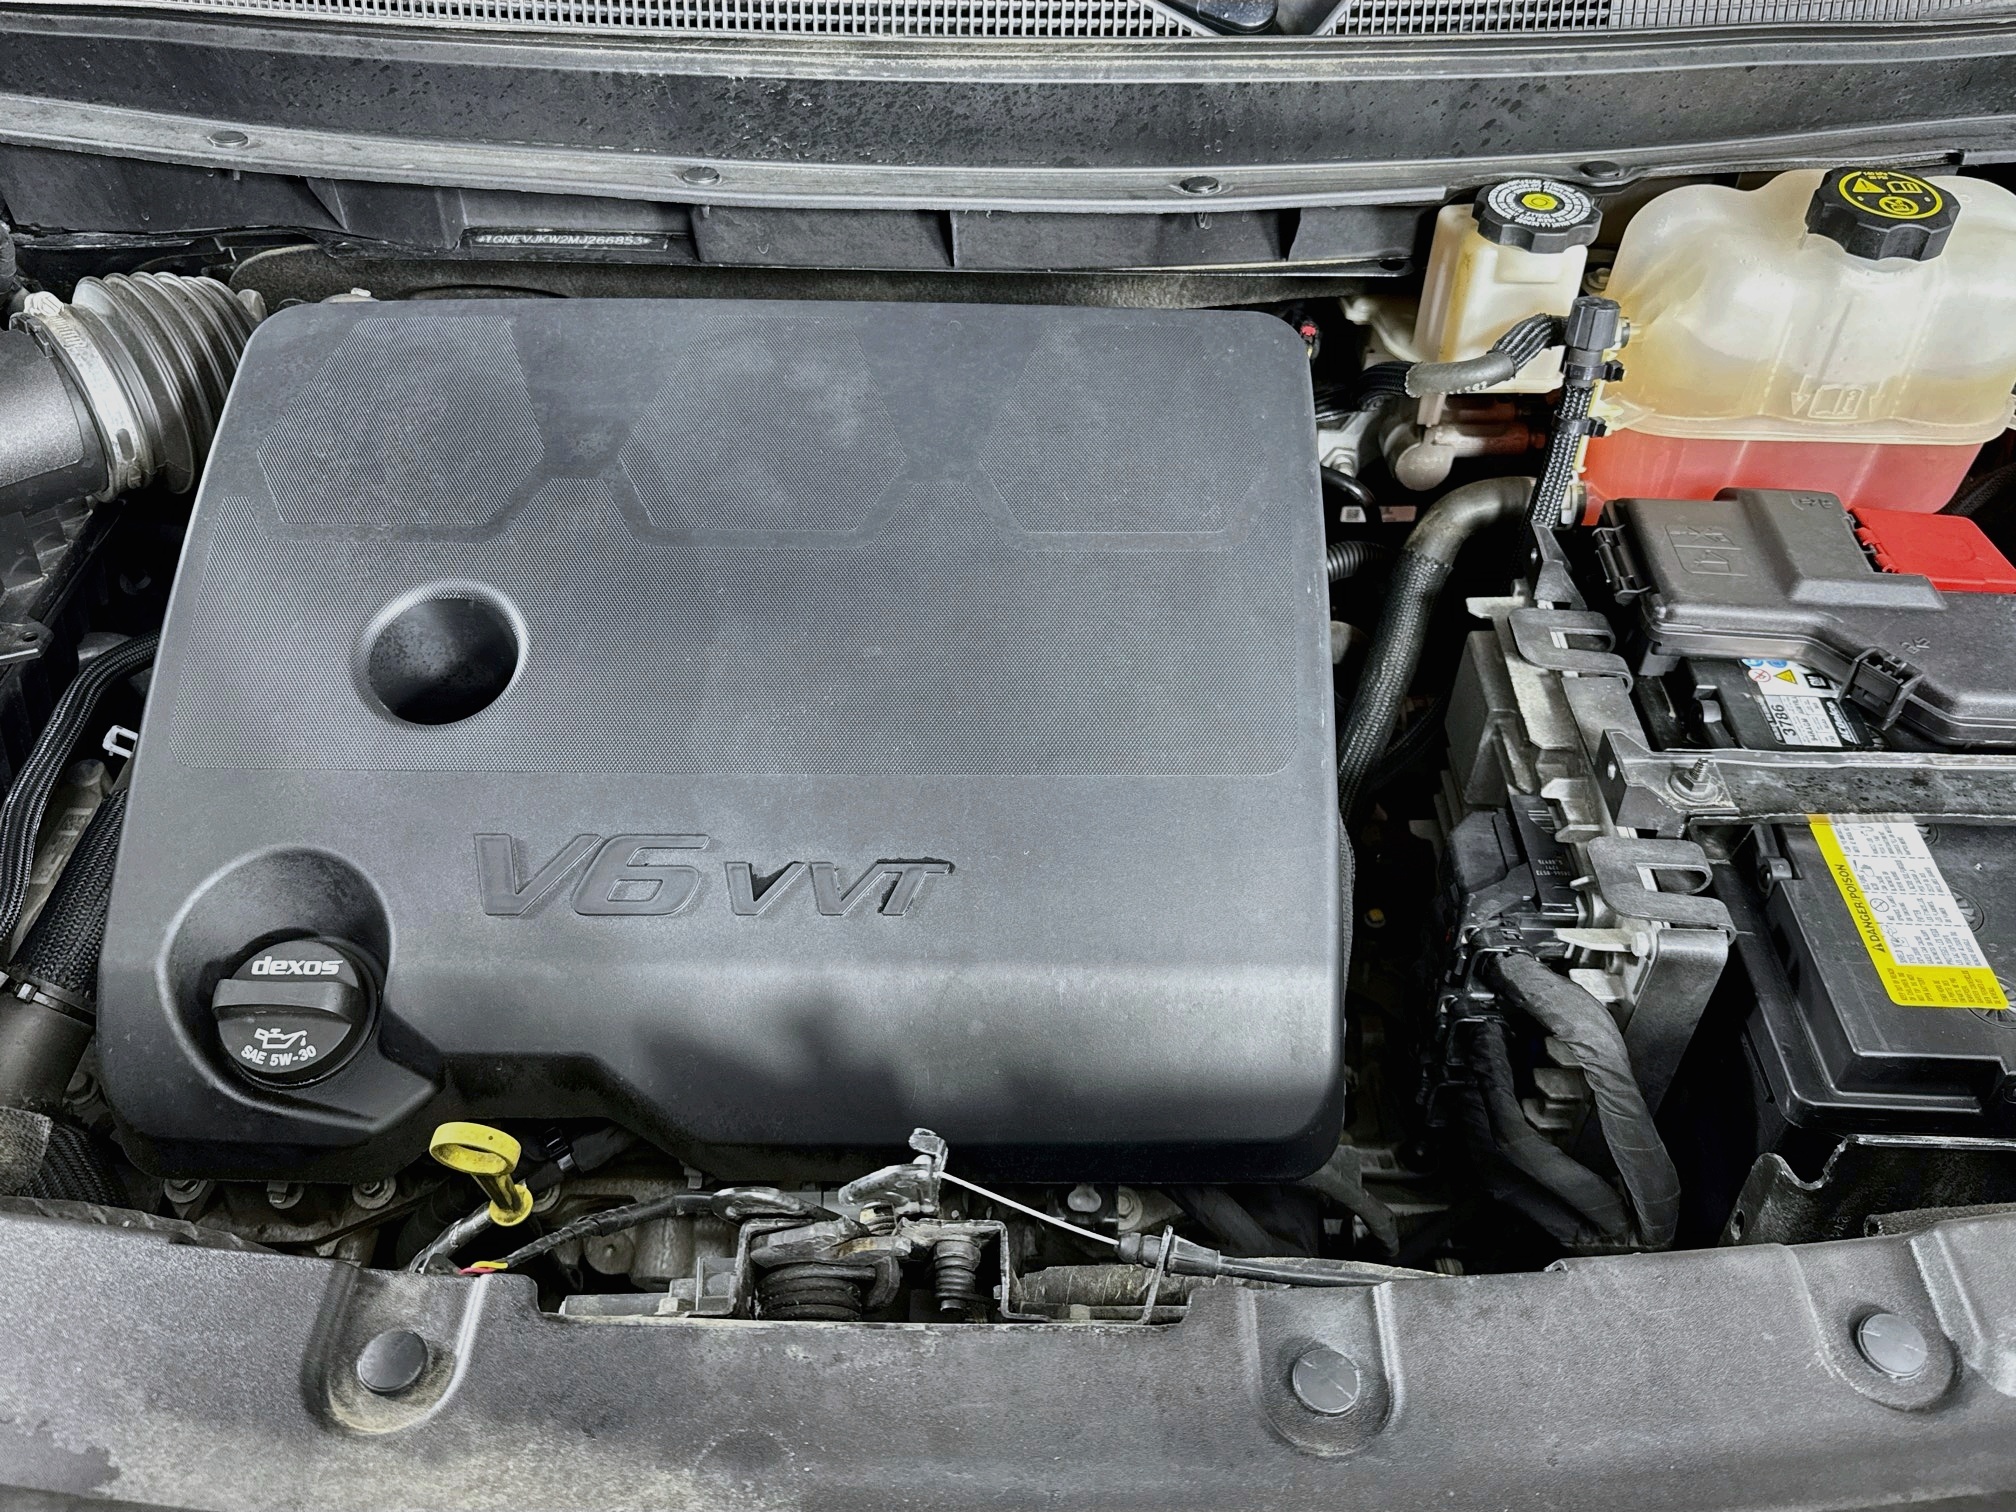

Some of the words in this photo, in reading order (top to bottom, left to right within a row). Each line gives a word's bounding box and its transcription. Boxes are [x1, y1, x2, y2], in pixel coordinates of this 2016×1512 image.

[1771, 704, 1797, 737] 3786
[474, 834, 711, 916] V6
[725, 857, 955, 916] VVT
[251, 956, 343, 976] dexos
[241, 1045, 267, 1065] SAE
[270, 1045, 317, 1067] 5W-30
